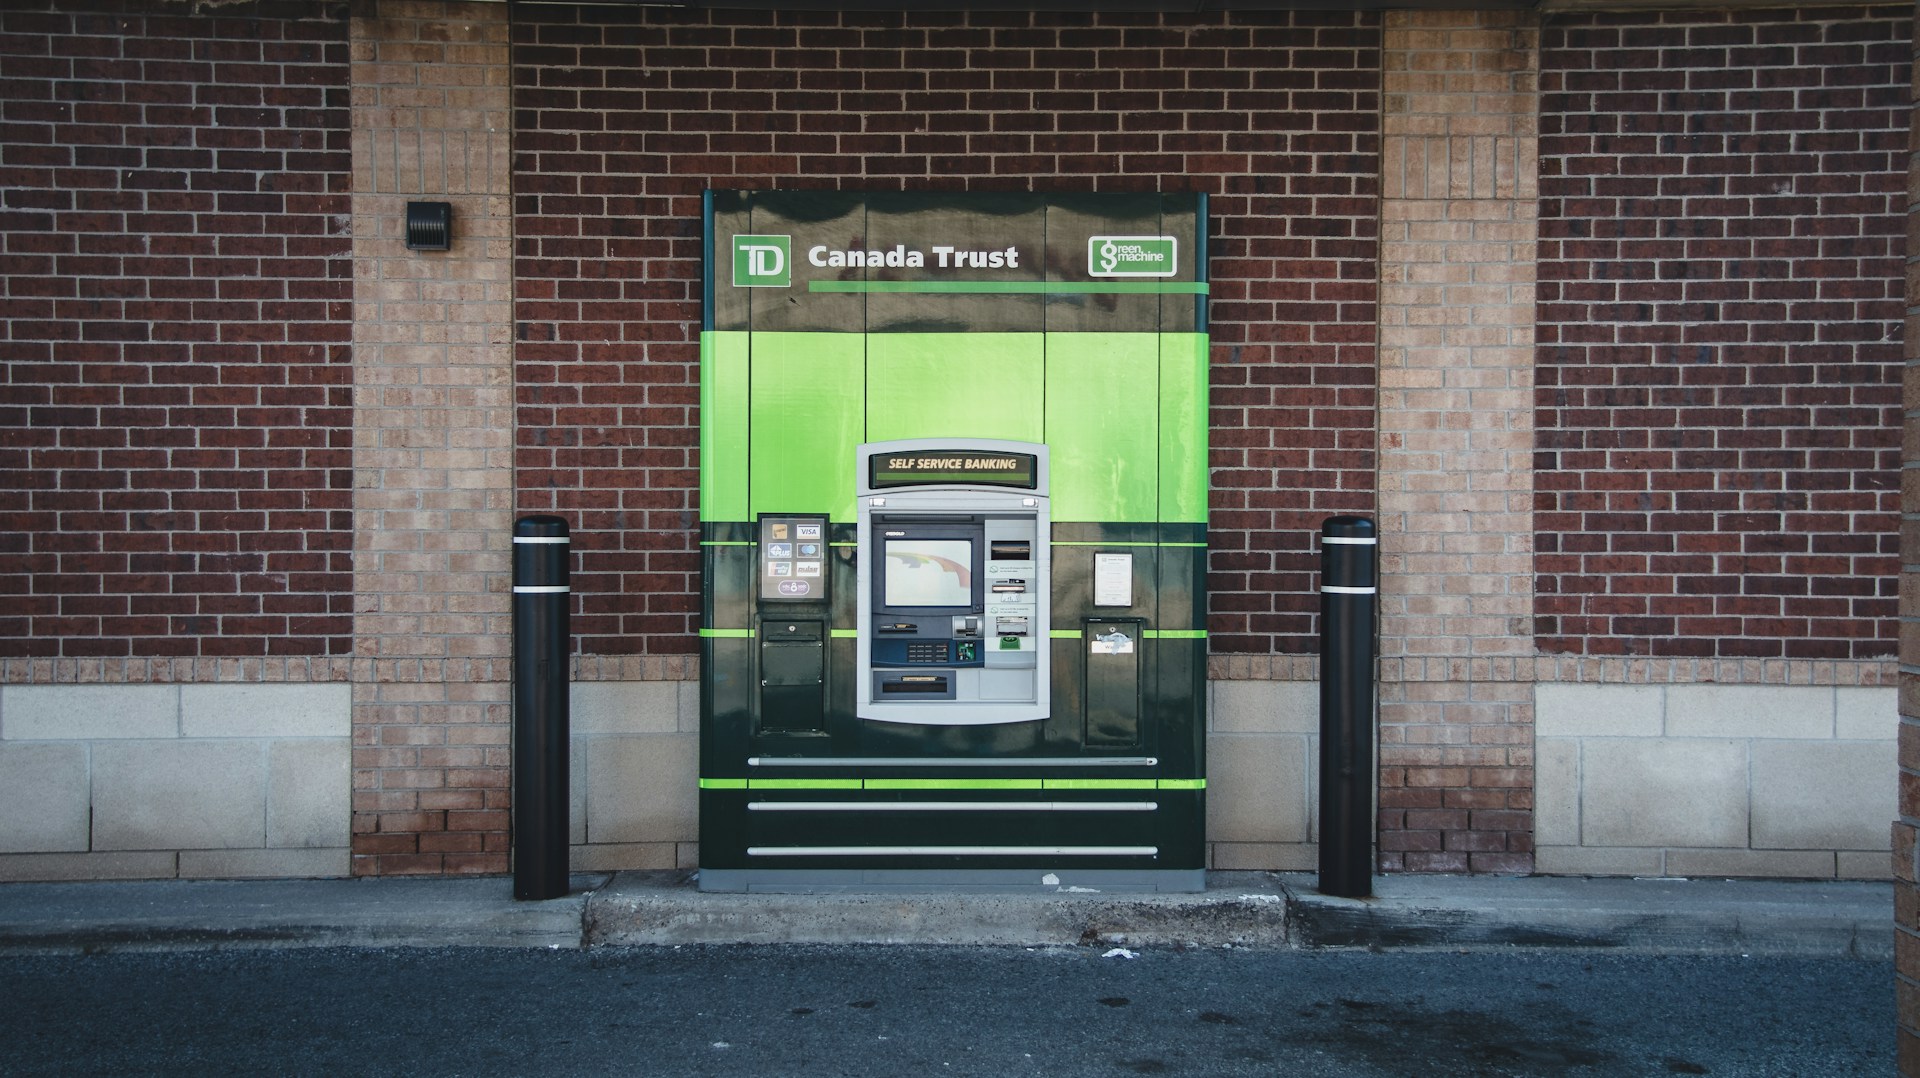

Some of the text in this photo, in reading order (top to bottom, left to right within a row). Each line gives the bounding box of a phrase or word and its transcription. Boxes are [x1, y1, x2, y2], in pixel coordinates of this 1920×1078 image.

[739, 244, 1019, 276] TD Canada Trust
[1117, 252, 1165, 263] machine
[888, 458, 1017, 470] SELF SERVICE BANKING
